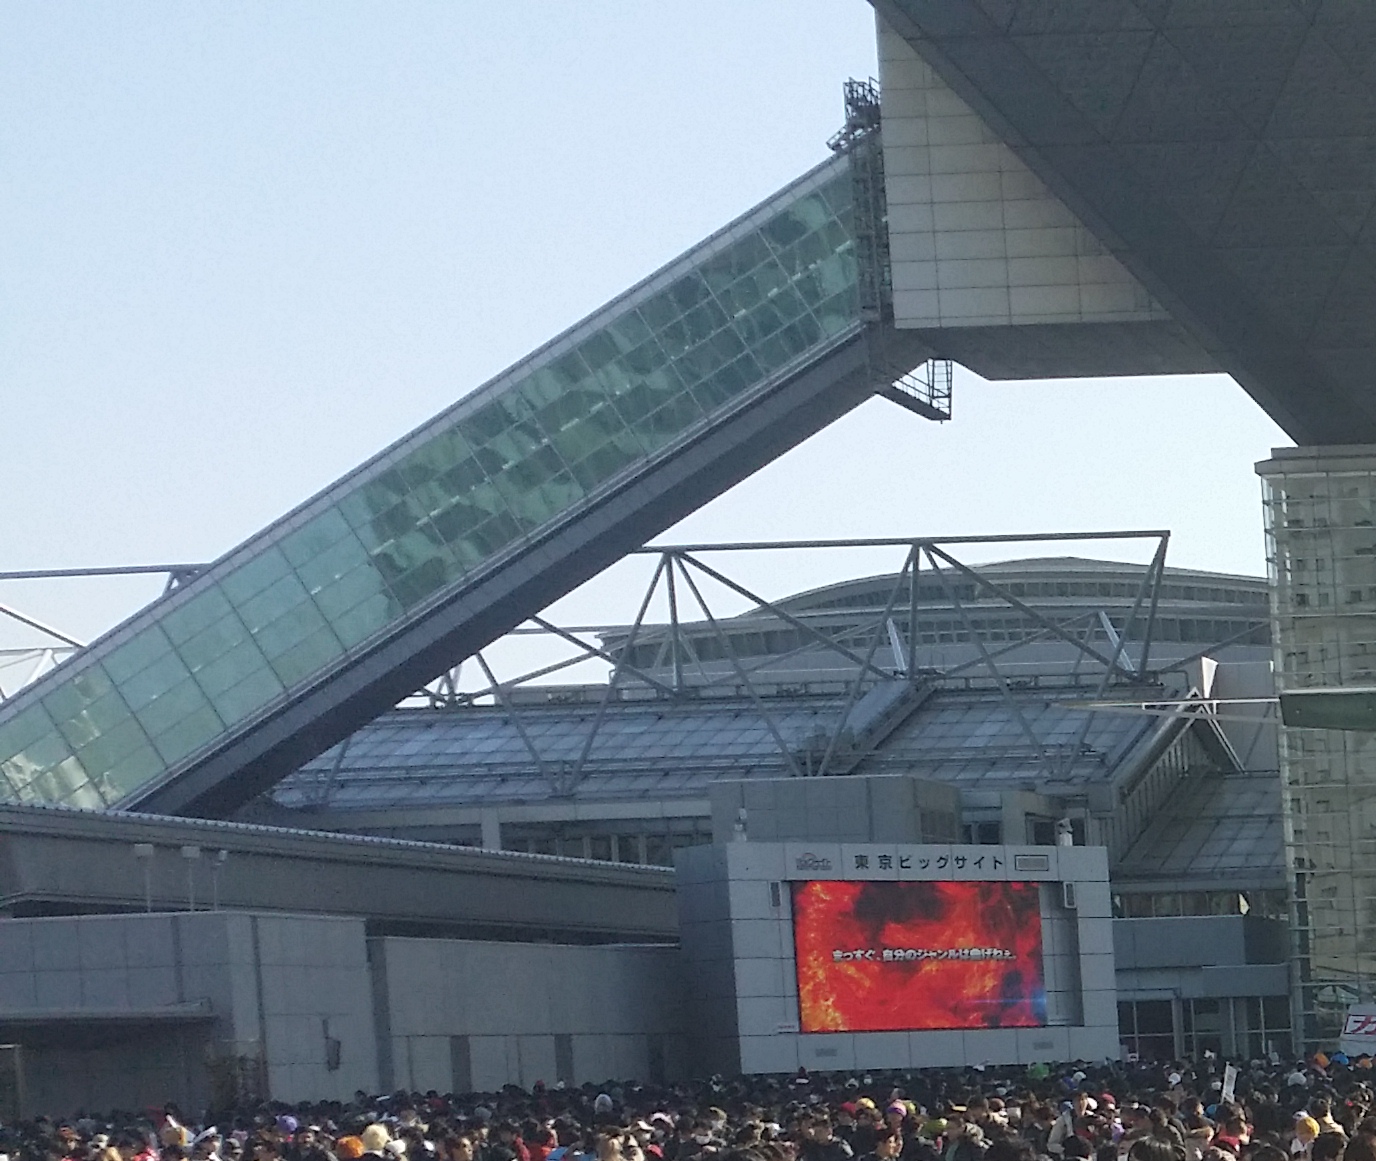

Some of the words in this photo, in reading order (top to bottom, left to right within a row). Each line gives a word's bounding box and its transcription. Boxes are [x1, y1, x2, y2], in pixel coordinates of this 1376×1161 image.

[854, 853, 1004, 871] 東京ビッグサイト
